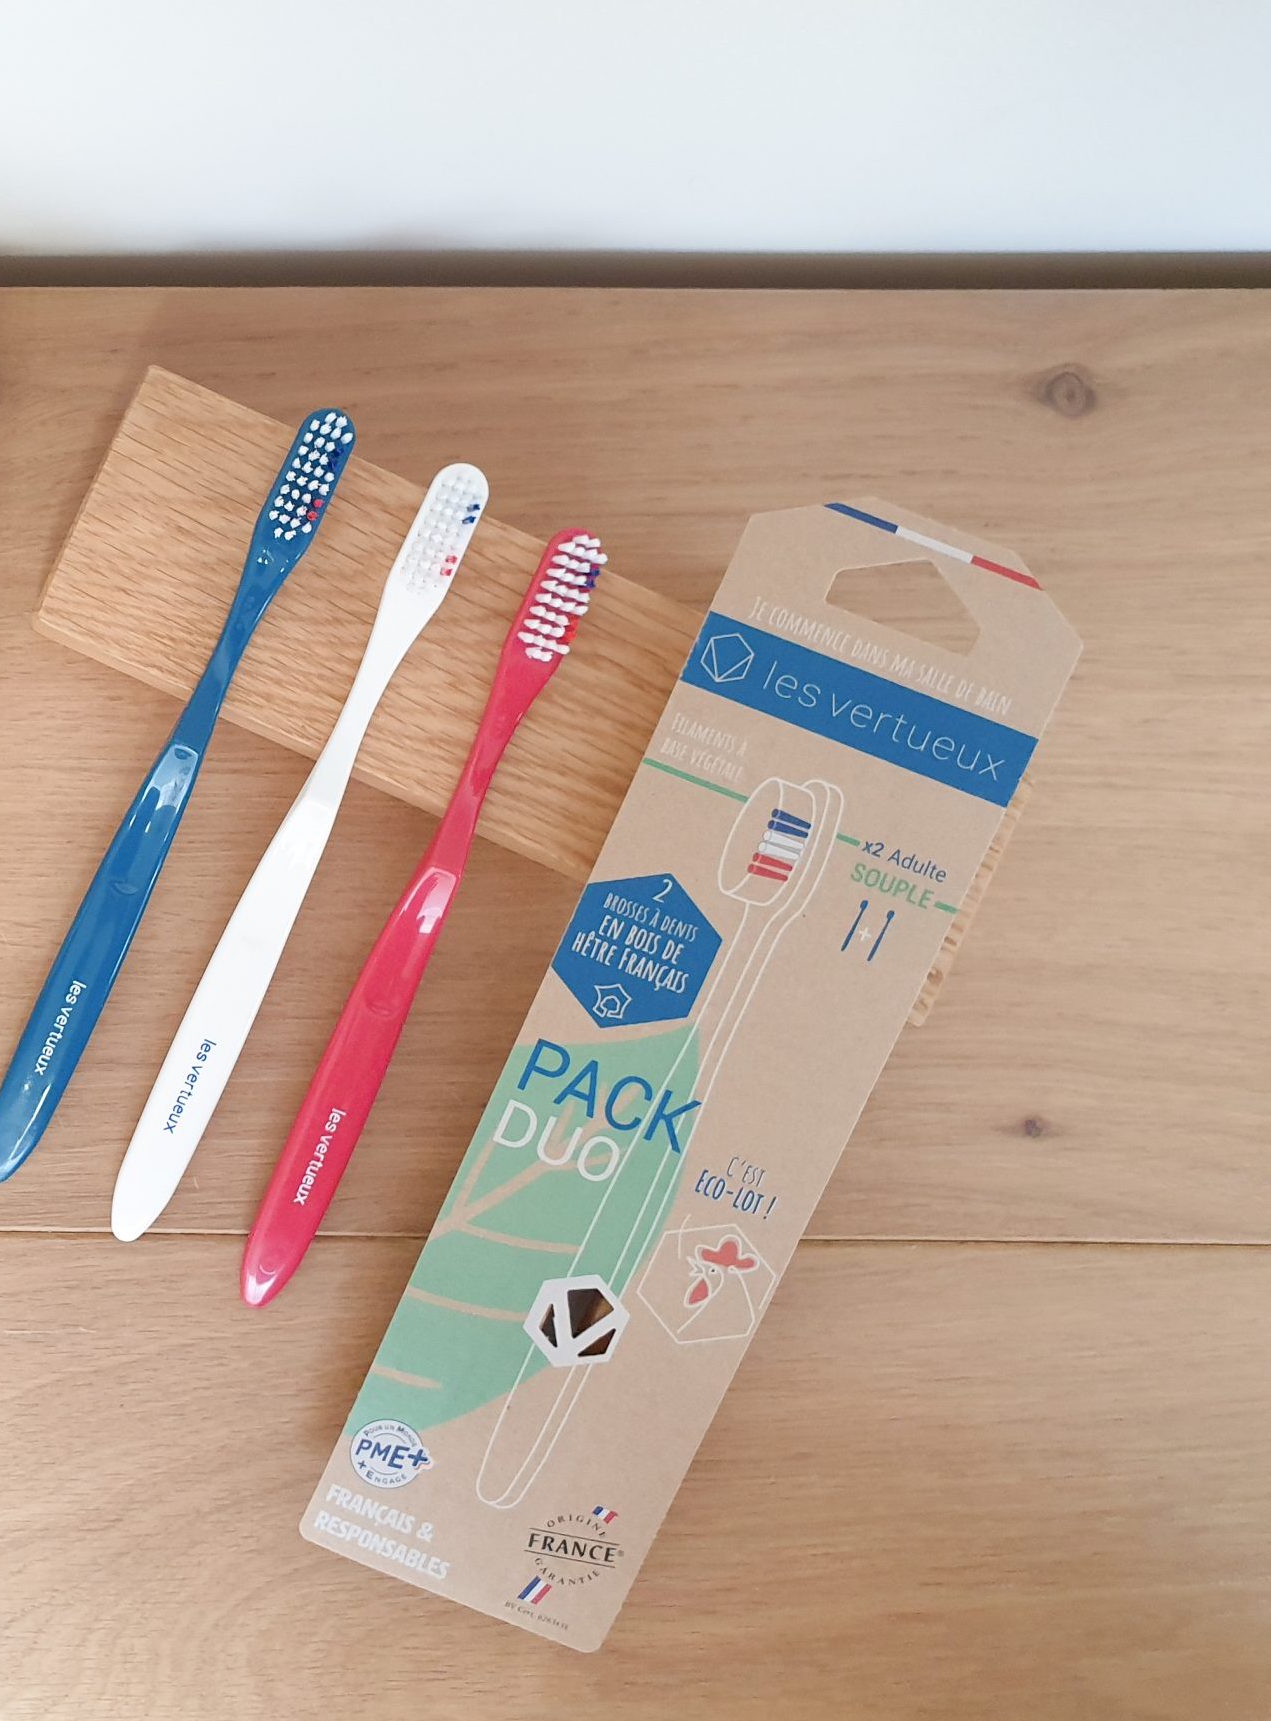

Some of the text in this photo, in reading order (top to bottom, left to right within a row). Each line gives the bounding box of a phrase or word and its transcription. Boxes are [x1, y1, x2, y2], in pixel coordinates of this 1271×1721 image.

[749, 596, 1012, 715] JE COMMENCE DANS MA SALLE DE BAIN
[672, 712, 735, 752] FILAMENTS
[762, 660, 1006, 781] les vertueux
[850, 862, 935, 910] SOUPLE
[862, 841, 947, 883] x2 Adulte
[652, 878, 673, 904] 2
[598, 915, 685, 965] EN BOIS DE
[603, 892, 699, 942] BROSSES À DENTS
[571, 930, 689, 994] HÊTRE FRANÇAIS
[34, 980, 87, 1076] les vertueux
[163, 1038, 217, 1134] les vertueux
[517, 1038, 702, 1154] PACK
[293, 1107, 347, 1206] les vertueux
[492, 1099, 620, 1182] DUO
[695, 1169, 765, 1215] ECO-LOT
[726, 1156, 766, 1187] C'EST
[326, 1483, 434, 1543] FRANÇAIS &
[547, 1514, 607, 1538] ORIGINE
[314, 1510, 450, 1580] RESPONSABLES
[528, 1533, 617, 1563] FRANCE
[534, 1557, 600, 1586] GARANTIE
